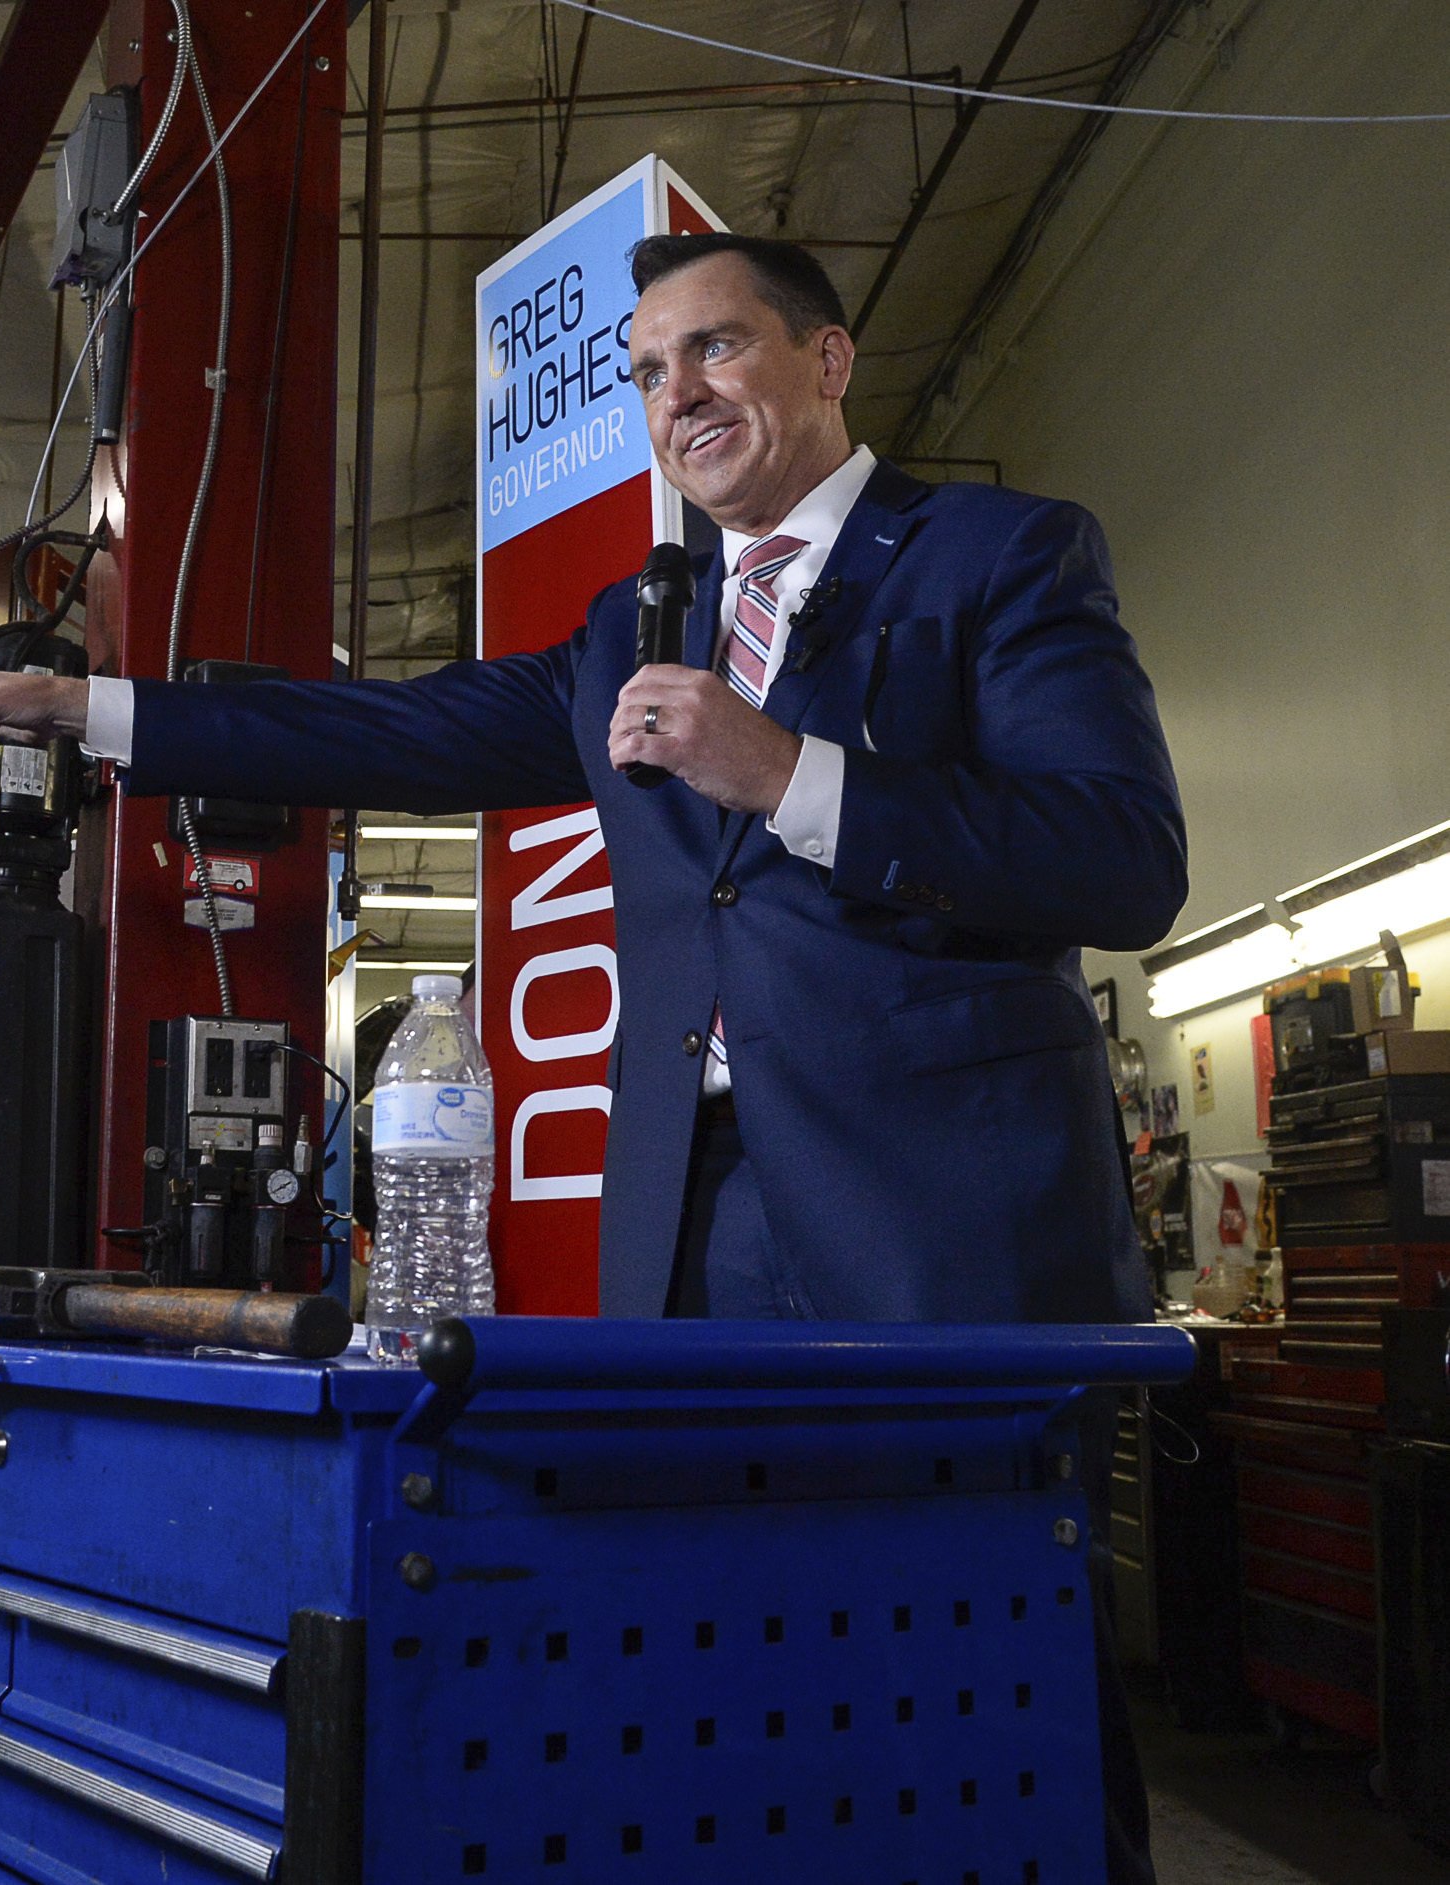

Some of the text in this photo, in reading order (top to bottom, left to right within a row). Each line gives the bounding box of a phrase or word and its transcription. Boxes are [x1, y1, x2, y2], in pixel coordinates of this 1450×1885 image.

[488, 264, 584, 380] GREG
[489, 311, 634, 463] HUGHES
[488, 406, 626, 517] GOVERNOR
